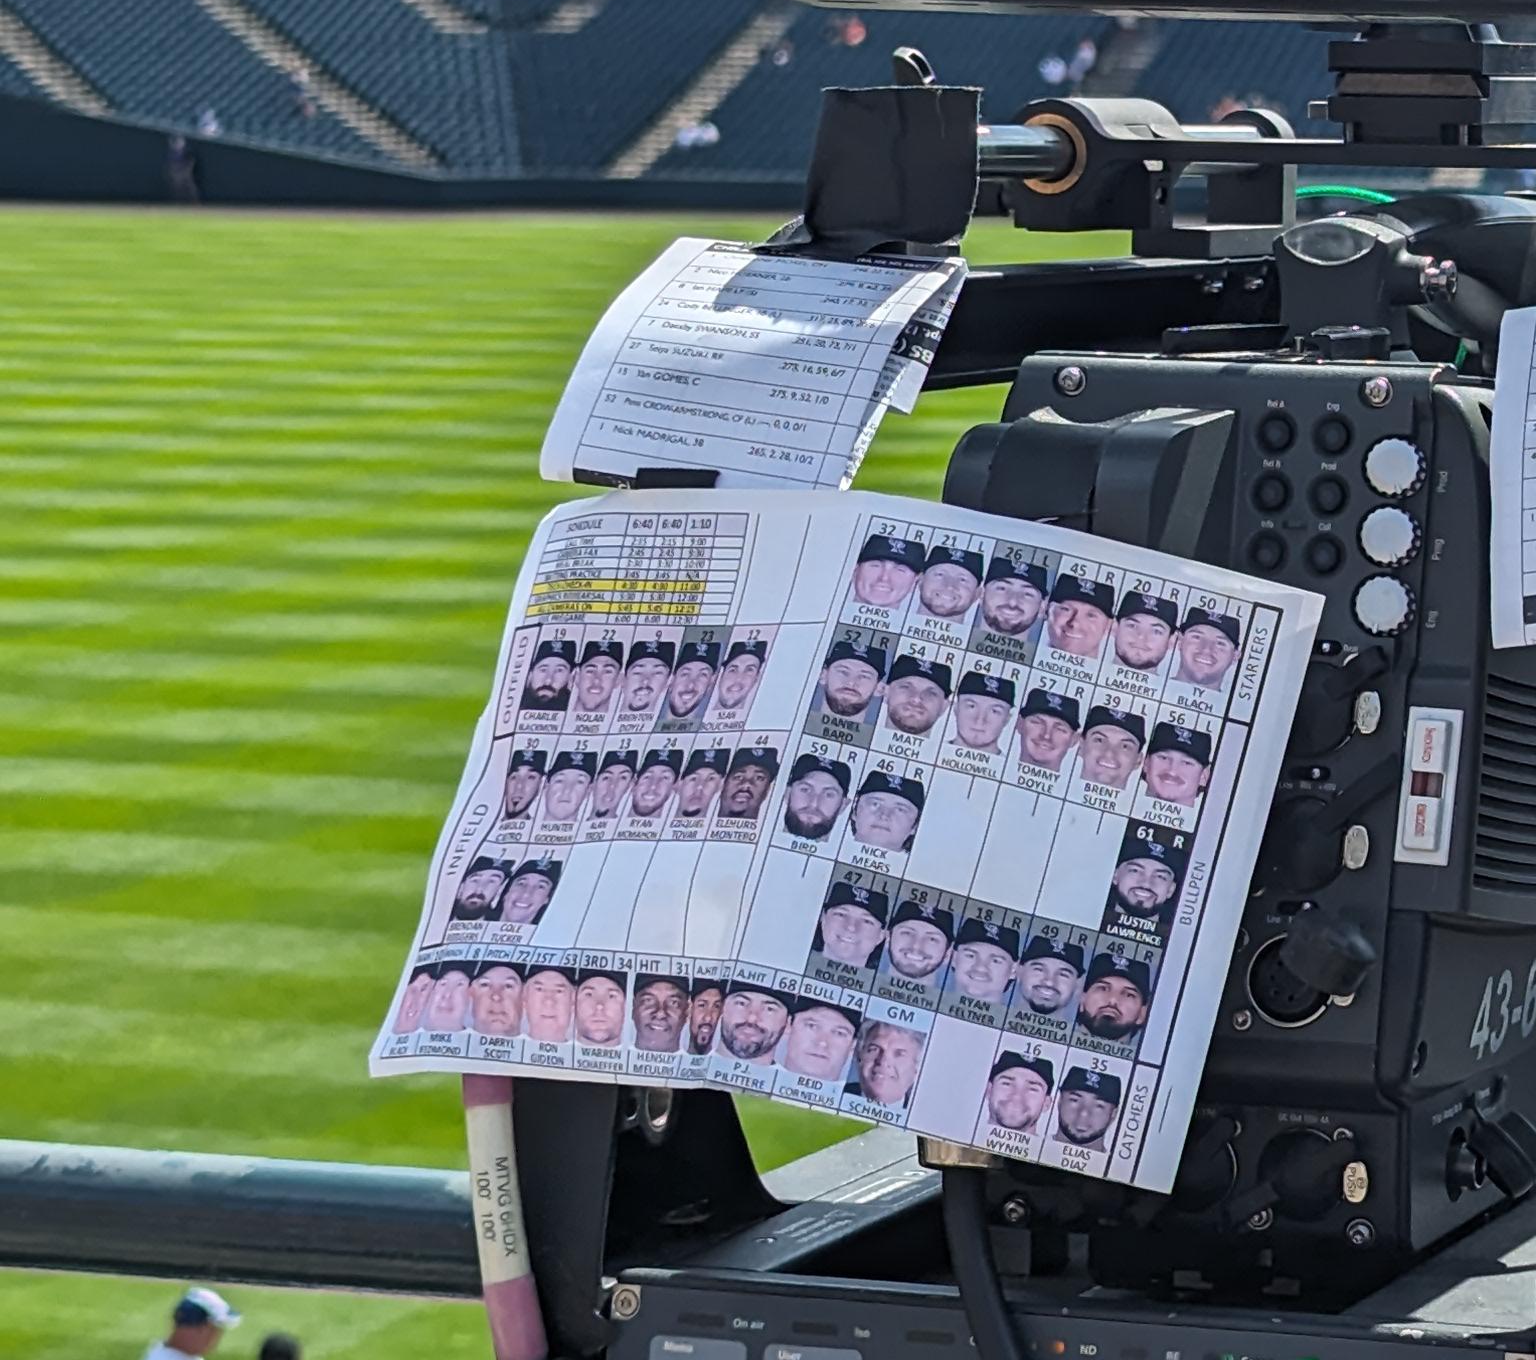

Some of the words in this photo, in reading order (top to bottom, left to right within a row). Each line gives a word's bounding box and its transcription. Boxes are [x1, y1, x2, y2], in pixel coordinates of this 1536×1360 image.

[1437, 470, 1448, 493] Prod
[631, 518, 654, 529] 6:40
[878, 523, 897, 536] 32
[941, 535, 957, 547] 21
[1005, 547, 1022, 561] 26
[1070, 562, 1087, 577] 45
[1133, 578, 1152, 593] 20
[1199, 595, 1217, 610] 50
[857, 605, 891, 619] CHRIS
[924, 618, 952, 632] KYLE
[843, 628, 861, 643] 52
[907, 626, 963, 646] FREELAND
[984, 632, 1025, 650] AUSTIN
[907, 643, 926, 657] 54
[975, 643, 1026, 662] GOMBER
[973, 659, 992, 673] 64
[1050, 650, 1085, 668] CHASE
[1239, 627, 1268, 700] STARTERS
[1037, 658, 1093, 682] ANDERSON
[1116, 668, 1150, 683] PETER
[1038, 676, 1057, 690] 57
[1105, 676, 1158, 698] LAMBERT
[1103, 694, 1121, 708] 39
[1177, 695, 1213, 713] BLACH
[821, 714, 861, 732] DANIEL
[1168, 710, 1186, 725] 56
[754, 735, 768, 747] 44
[822, 727, 854, 743] BARD
[891, 732, 925, 747] MATT
[810, 741, 829, 756] 59
[887, 743, 920, 759] KOCH
[954, 747, 991, 764] GAVIN
[876, 758, 895, 773] 46
[940, 757, 998, 778] HOLLOWELL
[1017, 763, 1061, 783] TOMMY
[1017, 776, 1054, 793] DOYLE
[1084, 783, 1120, 799] BRENT
[1082, 795, 1117, 811] SUTER
[1152, 801, 1182, 816] EVAN
[1143, 811, 1185, 828] JUSTICE
[447, 803, 489, 876] INFIELD
[1136, 826, 1154, 842] 61
[790, 840, 818, 853] BIRD
[860, 845, 888, 859] NICK
[851, 855, 890, 873] MEARS
[843, 870, 863, 885] 47
[909, 888, 929, 903] 58
[1179, 861, 1206, 926] BULLPEN
[975, 906, 994, 921] 18
[1118, 913, 1157, 932] JUSTIN
[1040, 924, 1060, 938] 49
[1106, 923, 1162, 945] LAWRENCE
[1106, 940, 1125, 955] 48
[534, 951, 555, 964] 1ST
[563, 952, 578, 966] 53
[584, 955, 609, 969] 3RD
[618, 957, 633, 971] 34
[639, 958, 661, 972] HIT
[675, 962, 690, 976] 31
[826, 959, 859, 976] RYAN
[736, 969, 768, 984] A.HIT
[778, 976, 797, 992] 68
[803, 982, 836, 1001] BULL
[889, 976, 926, 995] LUCAS
[846, 994, 864, 1009] 74
[959, 995, 991, 1011] RYAN
[886, 1006, 915, 1023] GM
[948, 1005, 995, 1025] FELTNER
[1014, 1009, 1068, 1031] ANTONIO
[538, 1042, 559, 1054] RON
[1023, 1041, 1042, 1057] 16
[1075, 1037, 1135, 1059] MARQUEZ
[1091, 1057, 1109, 1072] 35
[713, 1070, 767, 1090] PILITTERE
[848, 1101, 903, 1125] SCHMIDT
[1118, 1084, 1149, 1160] CATCHERS
[989, 1127, 1031, 1146] AUSTIN
[985, 1139, 1030, 1158] WYNNS
[1062, 1145, 1092, 1161] ELIAS
[1060, 1157, 1087, 1172] DIAZ
[495, 1156, 512, 1207] MTVG
[1347, 1166, 1357, 1198] PUSH
[733, 1318, 744, 1328] On
[745, 1319, 765, 1331] air
[1080, 1344, 1097, 1355] ND
